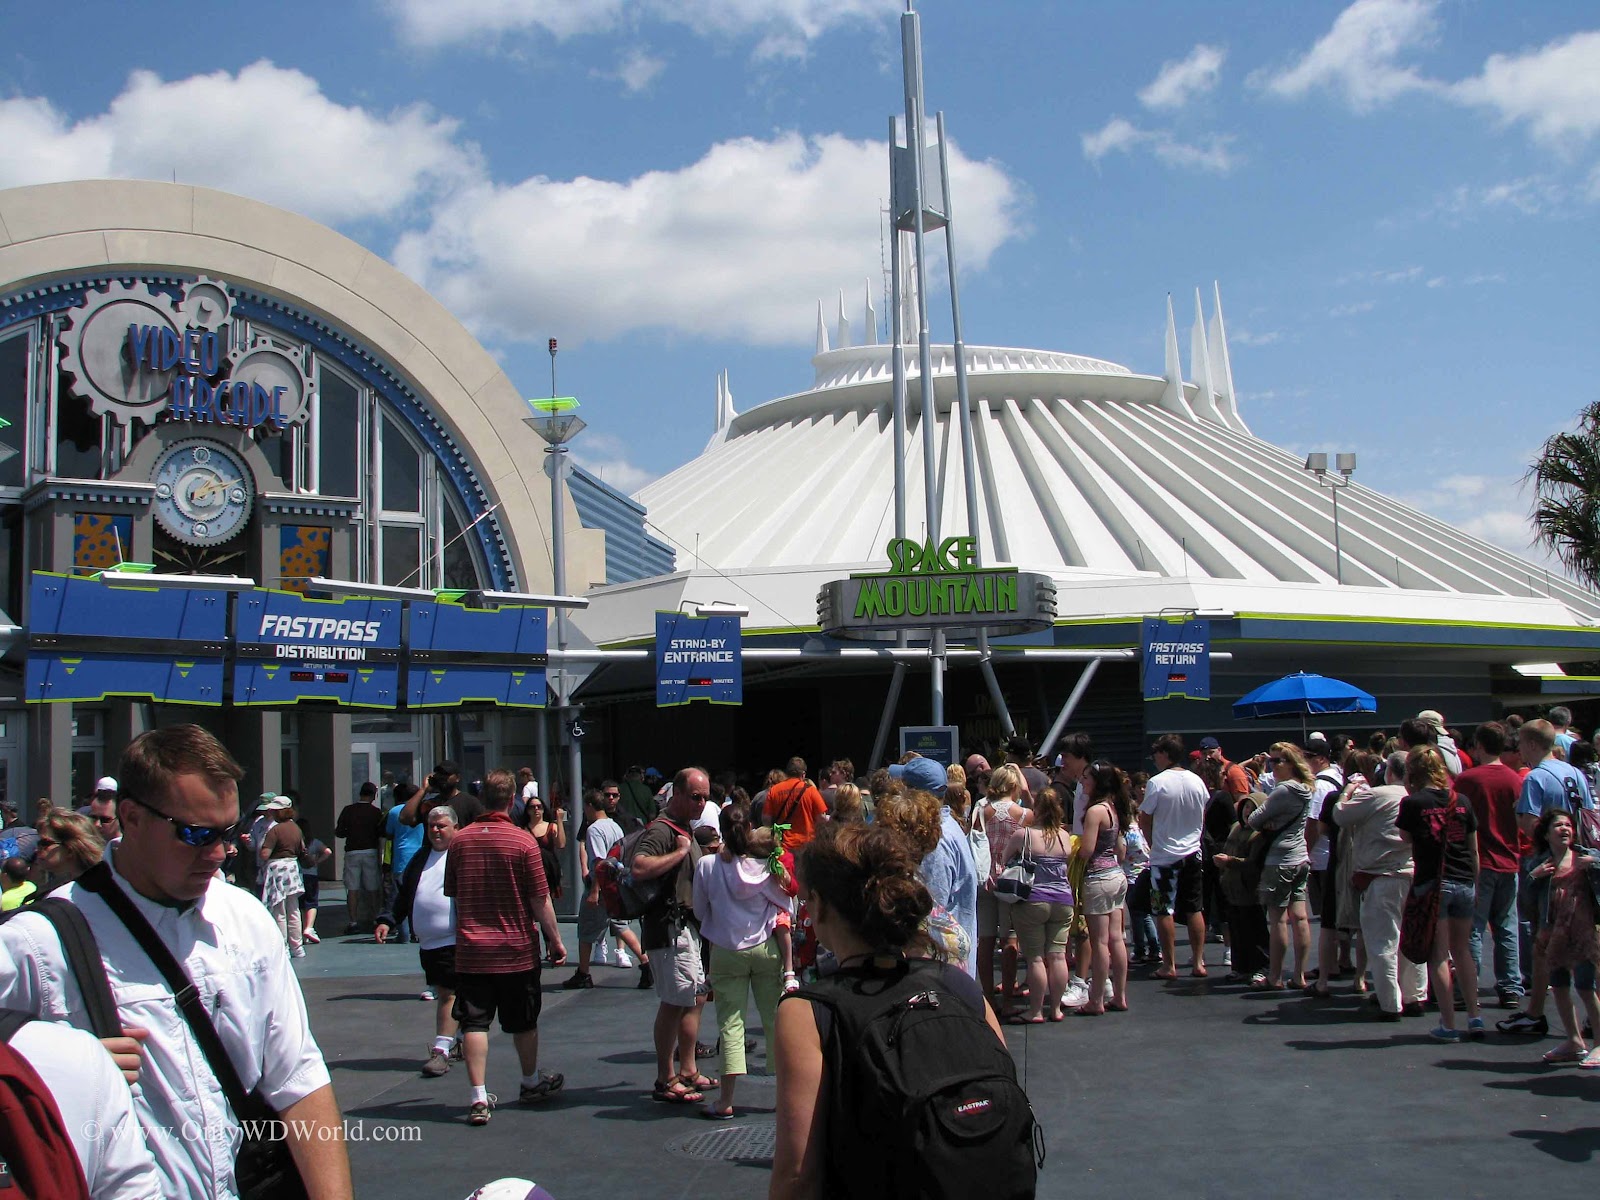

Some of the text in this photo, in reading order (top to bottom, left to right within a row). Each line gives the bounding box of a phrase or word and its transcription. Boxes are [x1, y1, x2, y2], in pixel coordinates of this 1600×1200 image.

[130, 323, 219, 376] VIDEO
[169, 375, 289, 429] ARCADE
[886, 535, 976, 573] SPACE
[854, 575, 1018, 620] MOUNTAIN
[259, 614, 381, 642] FASTPASS
[275, 644, 366, 661] DISTRIBUTION
[670, 639, 727, 649] STAND-BY
[1148, 642, 1205, 653] FASTPASS
[664, 651, 734, 663] ENTRANCE
[1155, 654, 1196, 665] RETURN
[957, 1099, 989, 1112] EASTPAK
